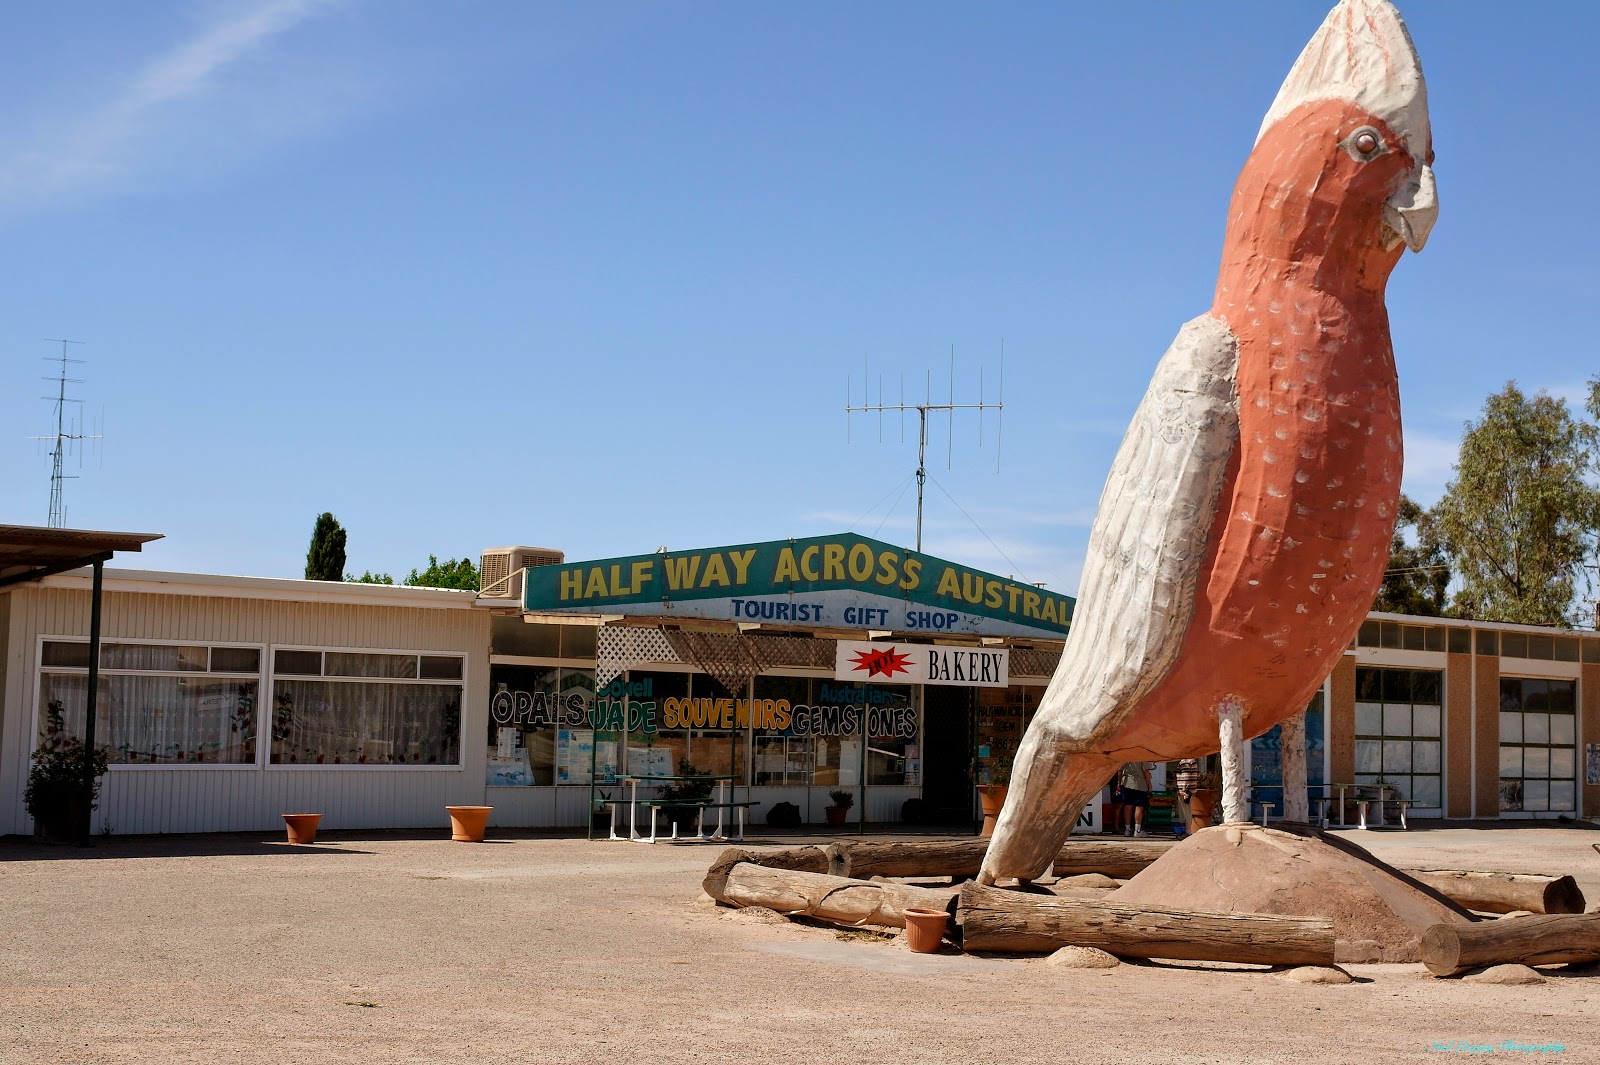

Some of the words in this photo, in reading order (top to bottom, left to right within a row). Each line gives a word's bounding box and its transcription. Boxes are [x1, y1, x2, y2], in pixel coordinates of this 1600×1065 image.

[560, 560, 654, 601] HALF
[664, 549, 758, 591] WAY
[774, 543, 923, 590] ACROSS
[936, 567, 1073, 627] AUSTRAL
[731, 599, 824, 622] TOURIST
[843, 606, 889, 626] GIFT
[906, 611, 959, 629] SHOP
[867, 652, 895, 675] HOT
[928, 650, 1003, 683] BAKERY
[492, 691, 585, 726] OPALS
[588, 700, 658, 734] JADE
[663, 697, 791, 730] SOUVENIRS
[791, 704, 918, 738] GEMSTONES
